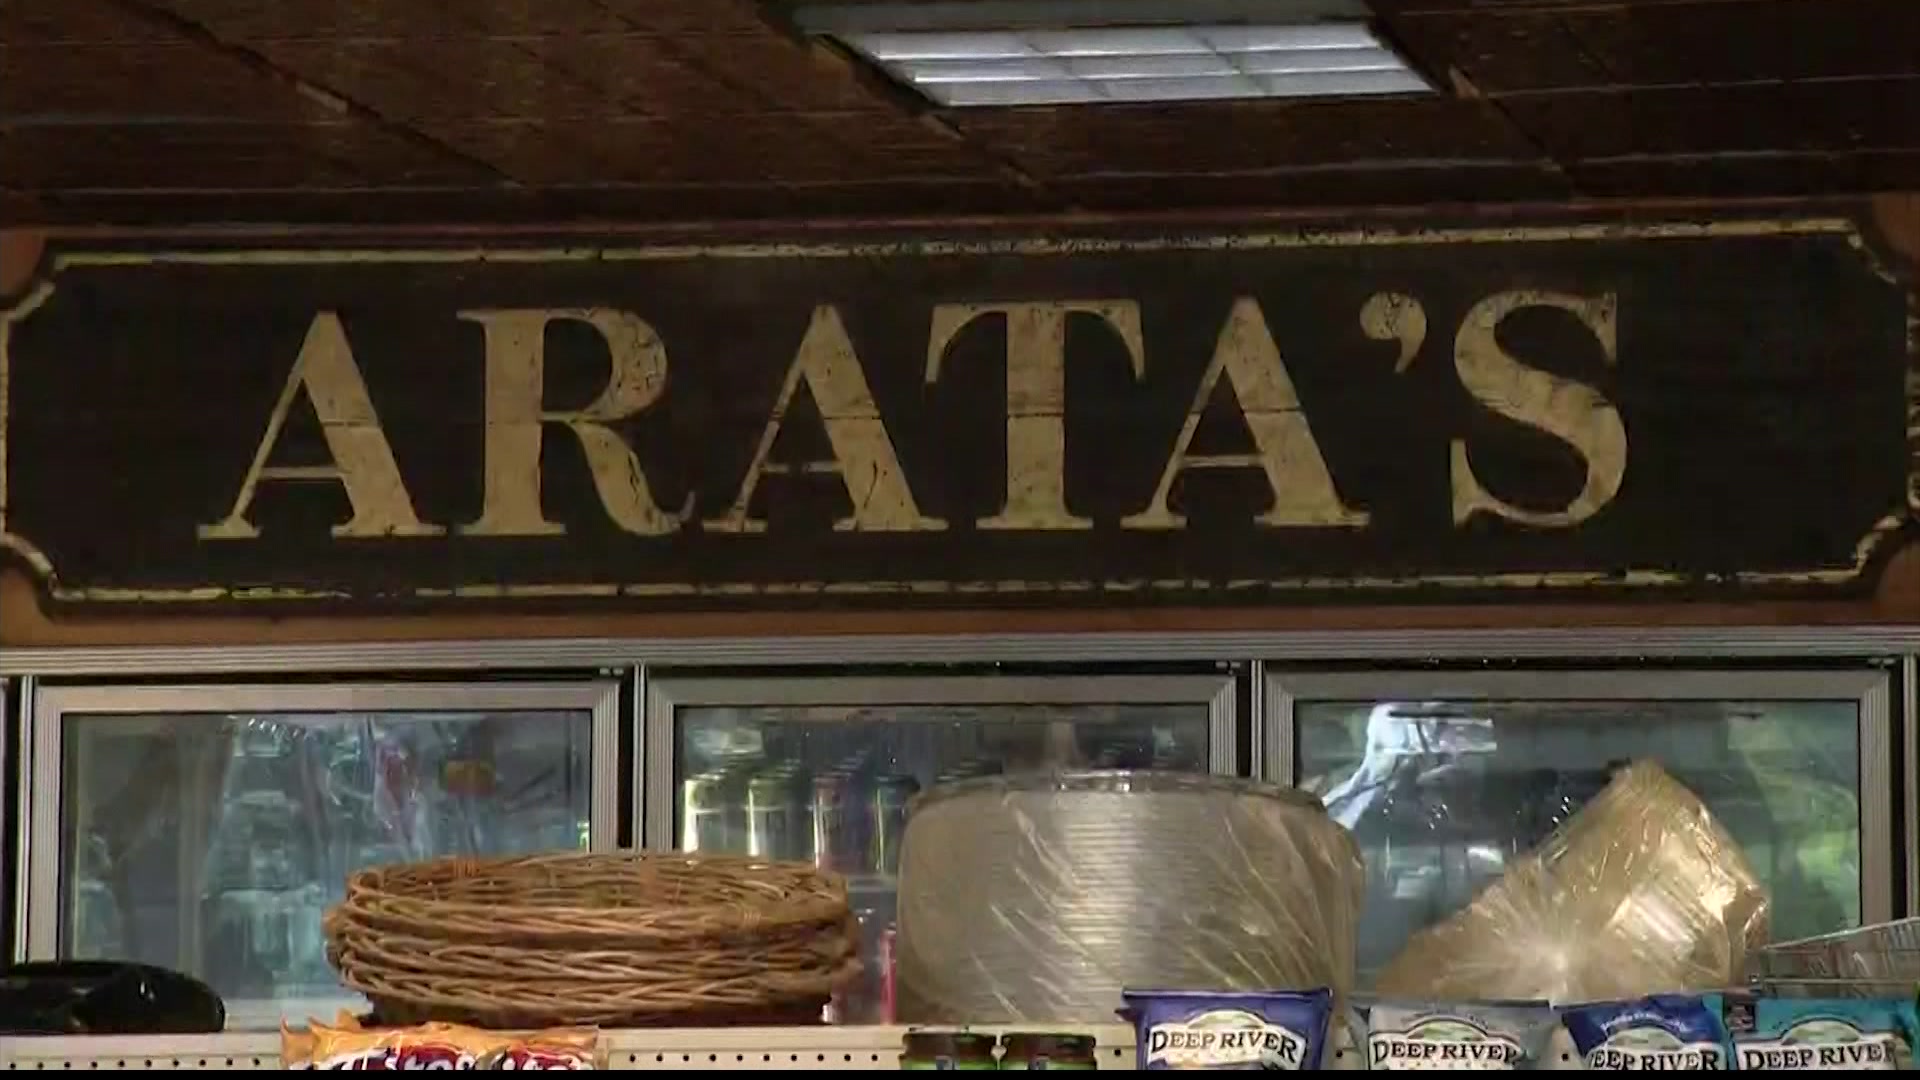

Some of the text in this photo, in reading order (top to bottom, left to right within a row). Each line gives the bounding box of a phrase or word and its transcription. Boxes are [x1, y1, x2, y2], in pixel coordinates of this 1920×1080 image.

[197, 289, 1628, 539] ARATA'S
[1151, 1029, 1297, 1064] DEEP RIVER
[1373, 1040, 1436, 1063] DEEP
[1640, 1049, 1719, 1070] RIVER
[1744, 1048, 1813, 1070] DEEP
